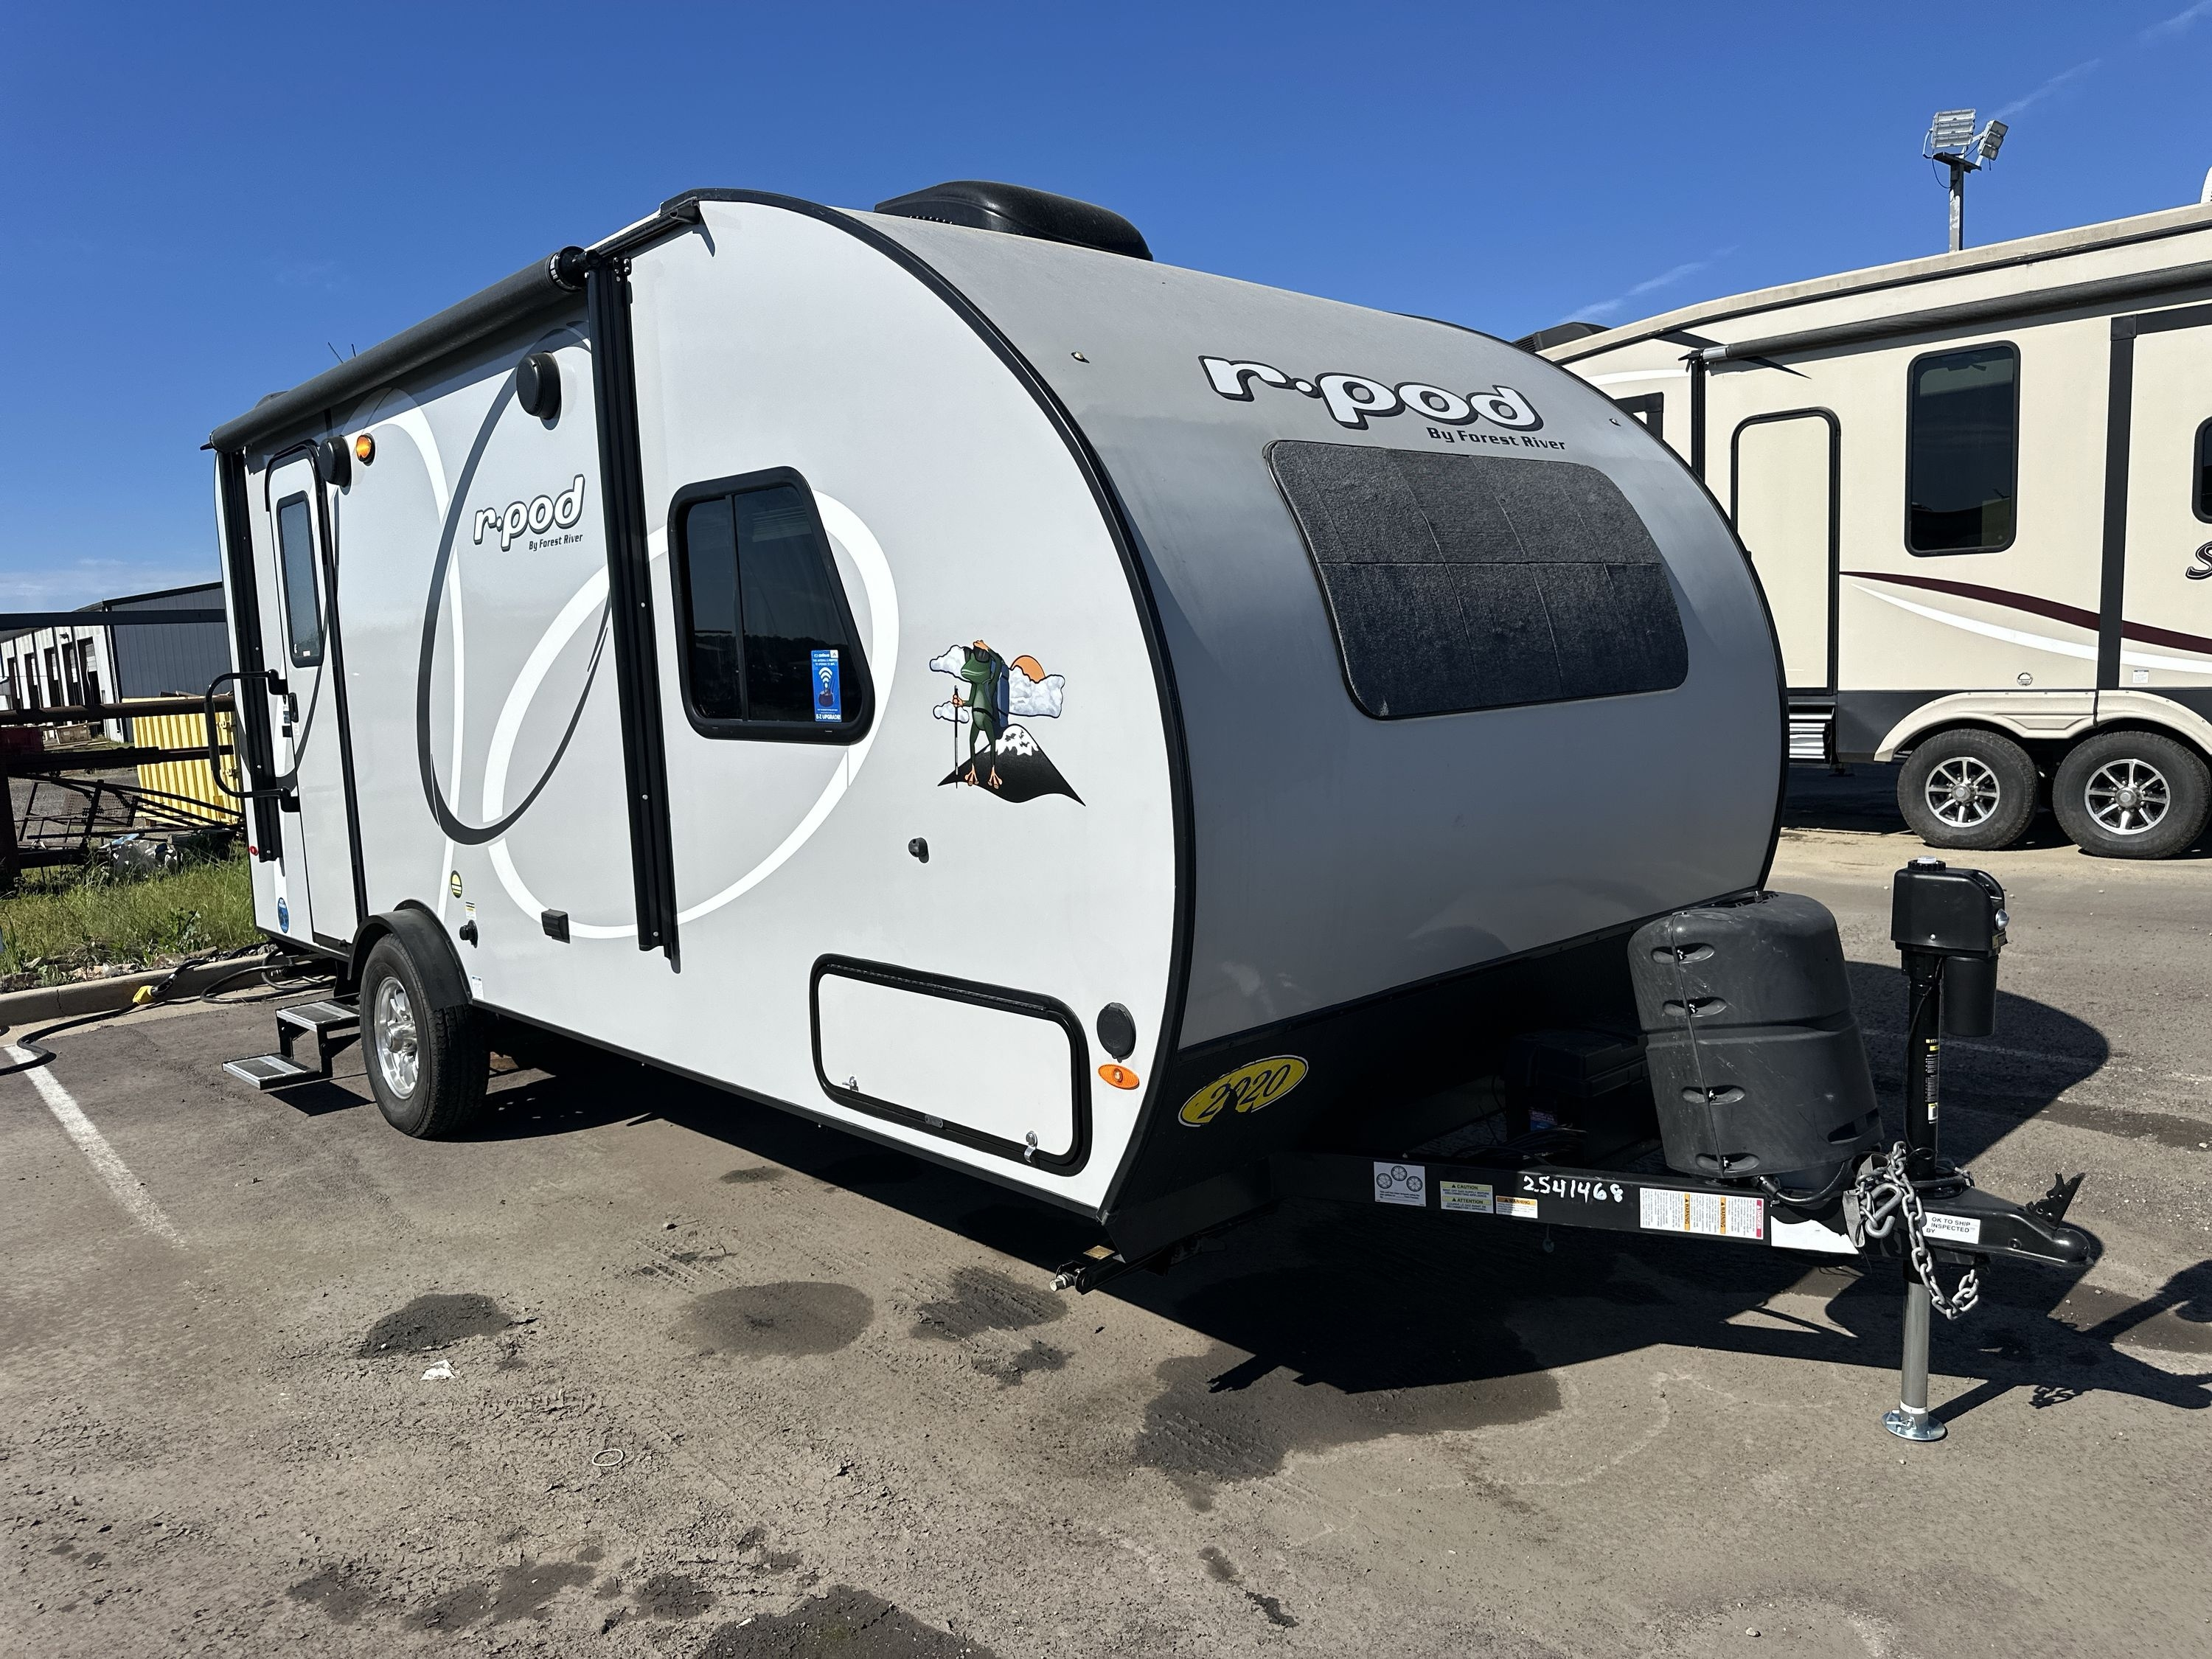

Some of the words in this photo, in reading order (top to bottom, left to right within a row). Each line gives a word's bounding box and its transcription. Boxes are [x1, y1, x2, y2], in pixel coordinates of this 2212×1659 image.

[1426, 427, 1455, 443] By
[1456, 430, 1520, 446] Forest
[1520, 436, 1565, 450] River
[529, 540, 538, 552] By
[539, 537, 563, 549] Forest
[563, 534, 583, 544] River
[1931, 1222, 1969, 1233] INSPECTED
